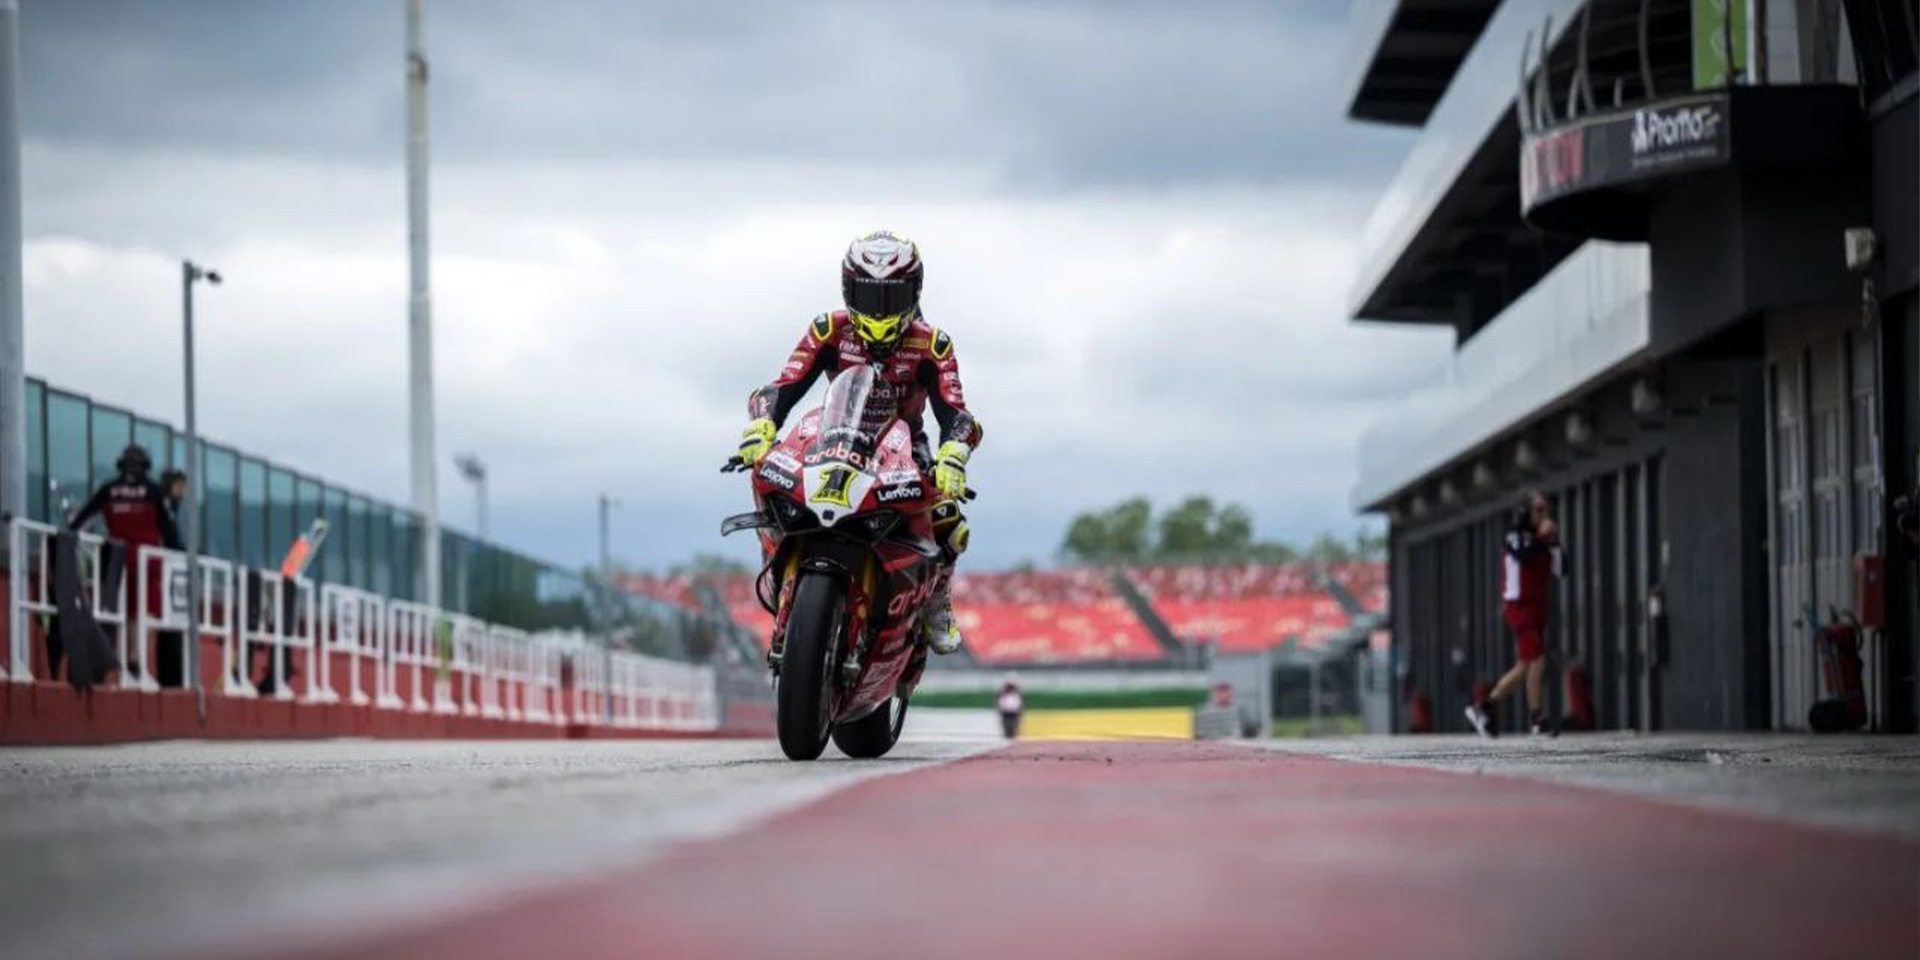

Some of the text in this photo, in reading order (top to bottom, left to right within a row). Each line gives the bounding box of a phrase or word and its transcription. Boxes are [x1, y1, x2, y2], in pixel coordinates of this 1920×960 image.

[760, 464, 795, 489] Lenovo
[811, 465, 858, 509] 1
[877, 486, 922, 502] Lenovo
